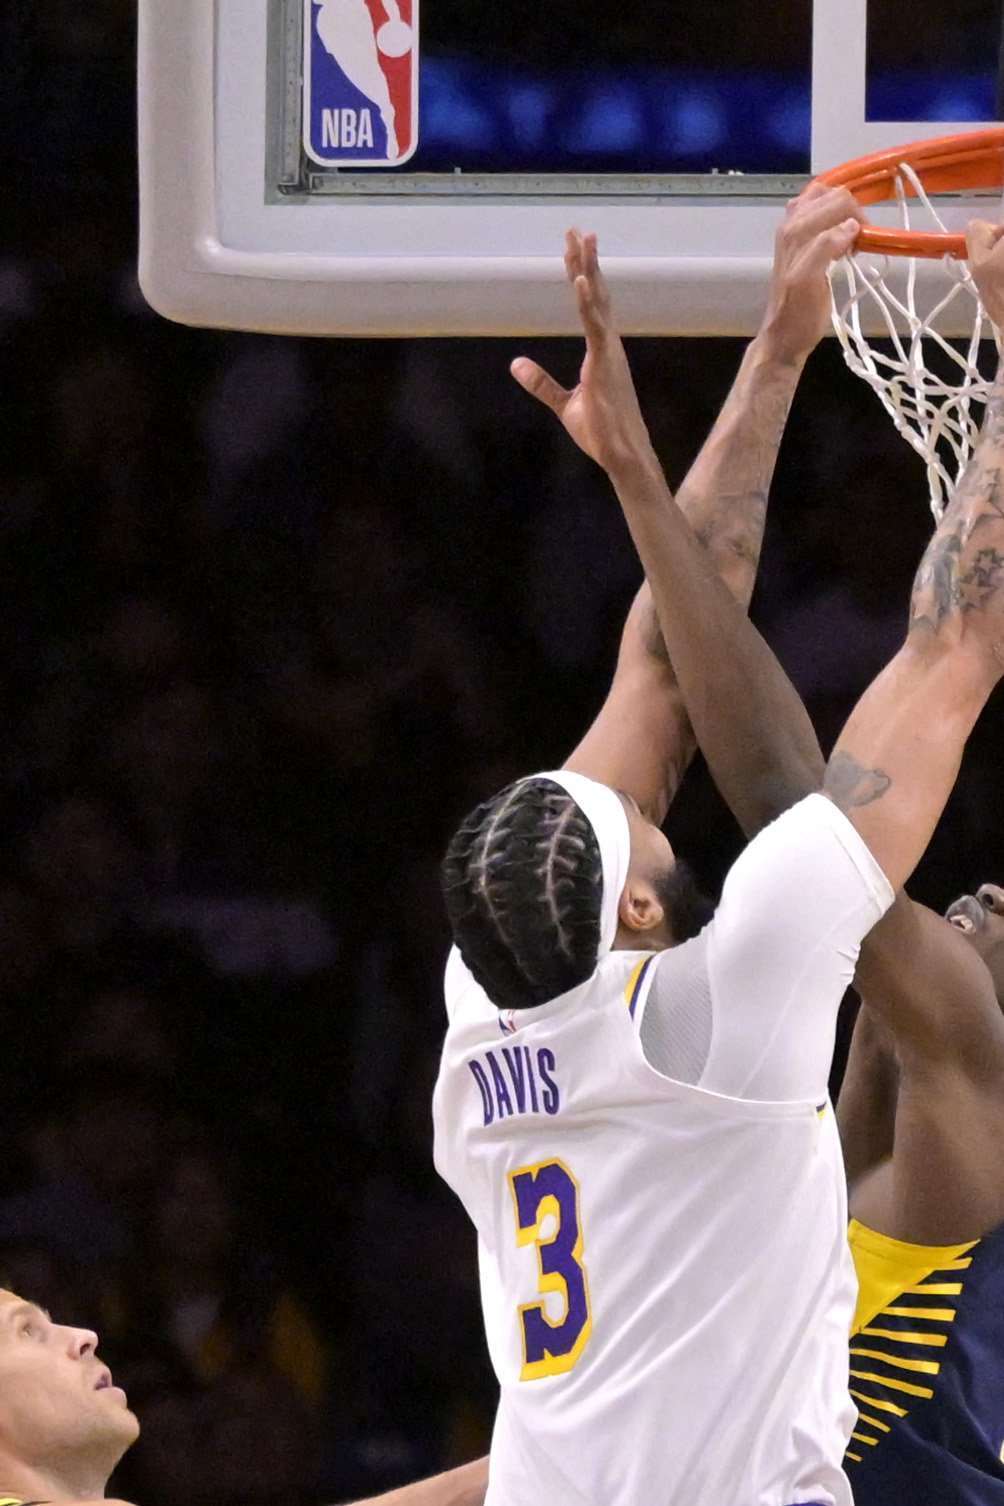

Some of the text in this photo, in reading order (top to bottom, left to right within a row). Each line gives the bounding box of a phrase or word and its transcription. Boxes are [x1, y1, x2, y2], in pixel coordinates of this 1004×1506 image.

[321, 107, 375, 149] NBA
[468, 1046, 560, 1127] DAVIS
[507, 1157, 593, 1382] 3
